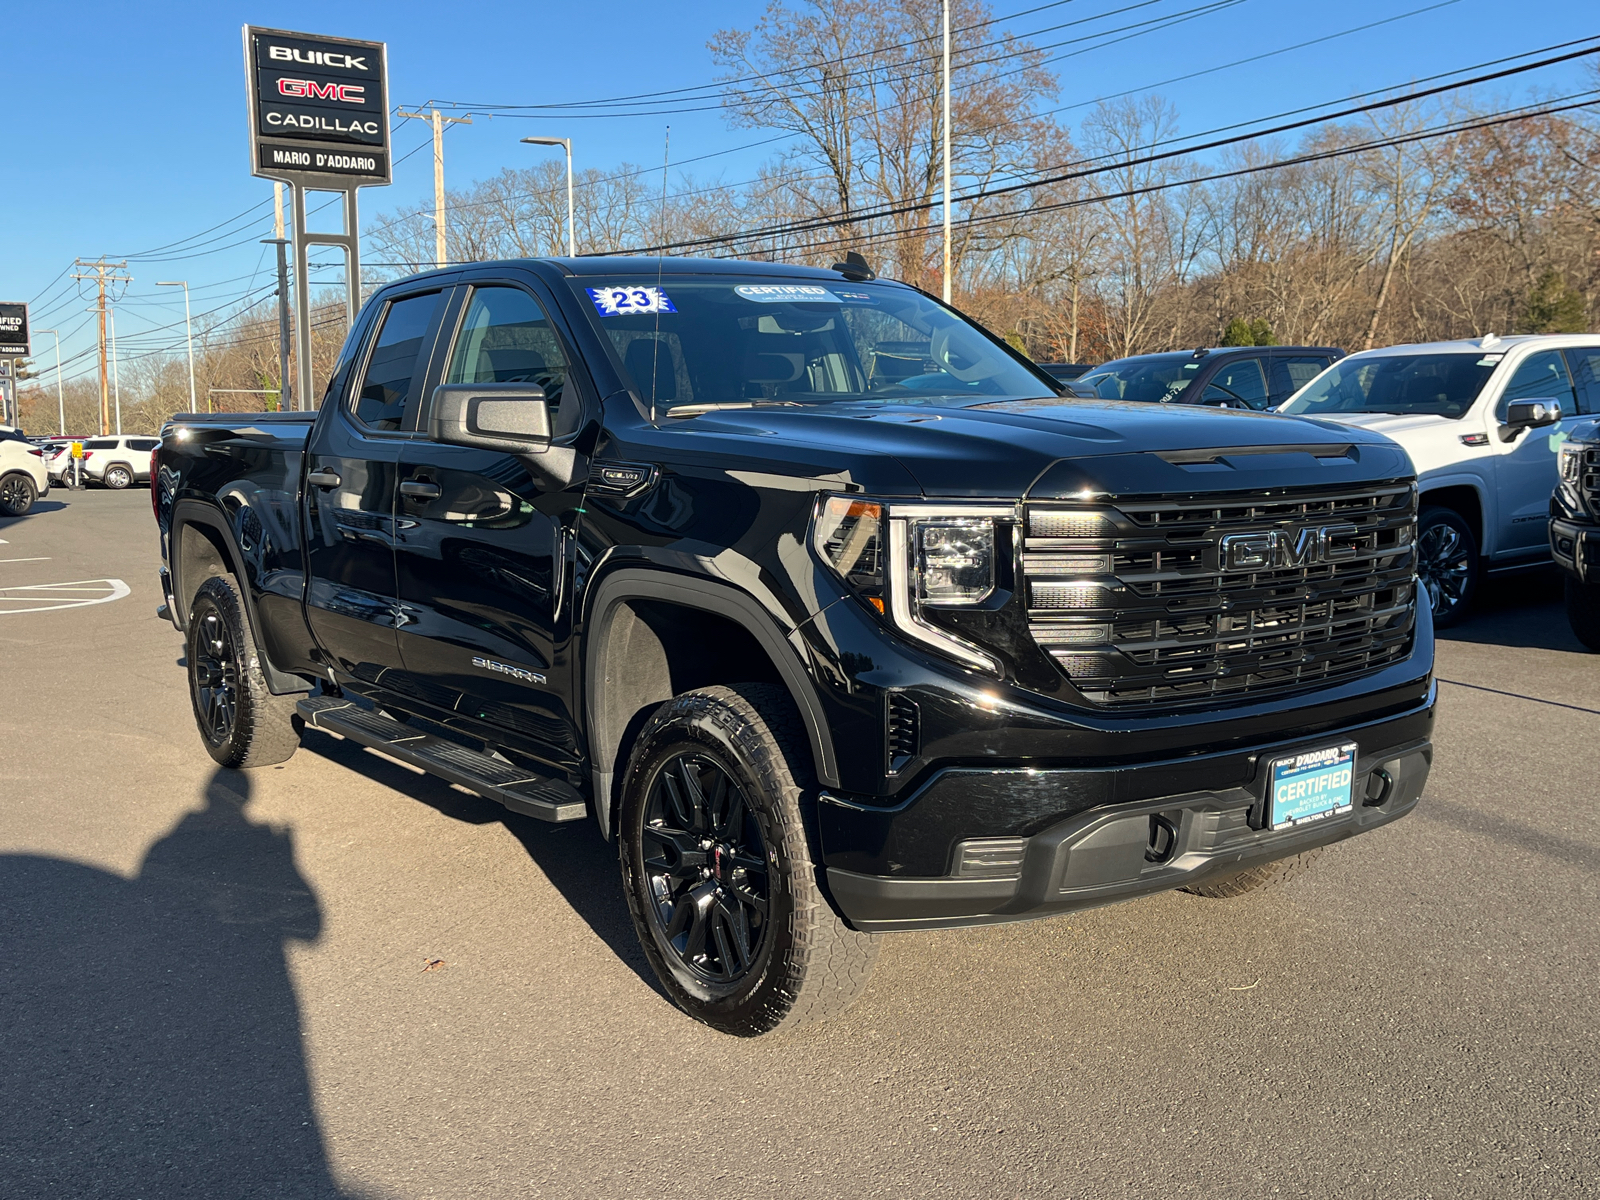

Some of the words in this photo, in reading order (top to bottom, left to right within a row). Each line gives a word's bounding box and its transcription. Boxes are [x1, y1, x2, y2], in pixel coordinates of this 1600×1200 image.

[269, 46, 368, 70] BUICK
[277, 77, 365, 104] GMC
[266, 112, 378, 134] CADILLAC
[273, 150, 311, 165] MARIO
[316, 153, 375, 171] D'ADDARIO
[612, 290, 651, 308] 23
[738, 286, 826, 295] CERTIFIED
[1512, 515, 1551, 523] DENAL
[1218, 523, 1358, 573] GMC
[471, 656, 547, 685] SIERRA
[1296, 747, 1339, 767] D'ADDARIO
[1277, 769, 1352, 803] CERTIFIED
[1282, 804, 1312, 818] CHEVROLET
[1312, 800, 1327, 809] BUICK
[1299, 796, 1319, 806] BACKED
